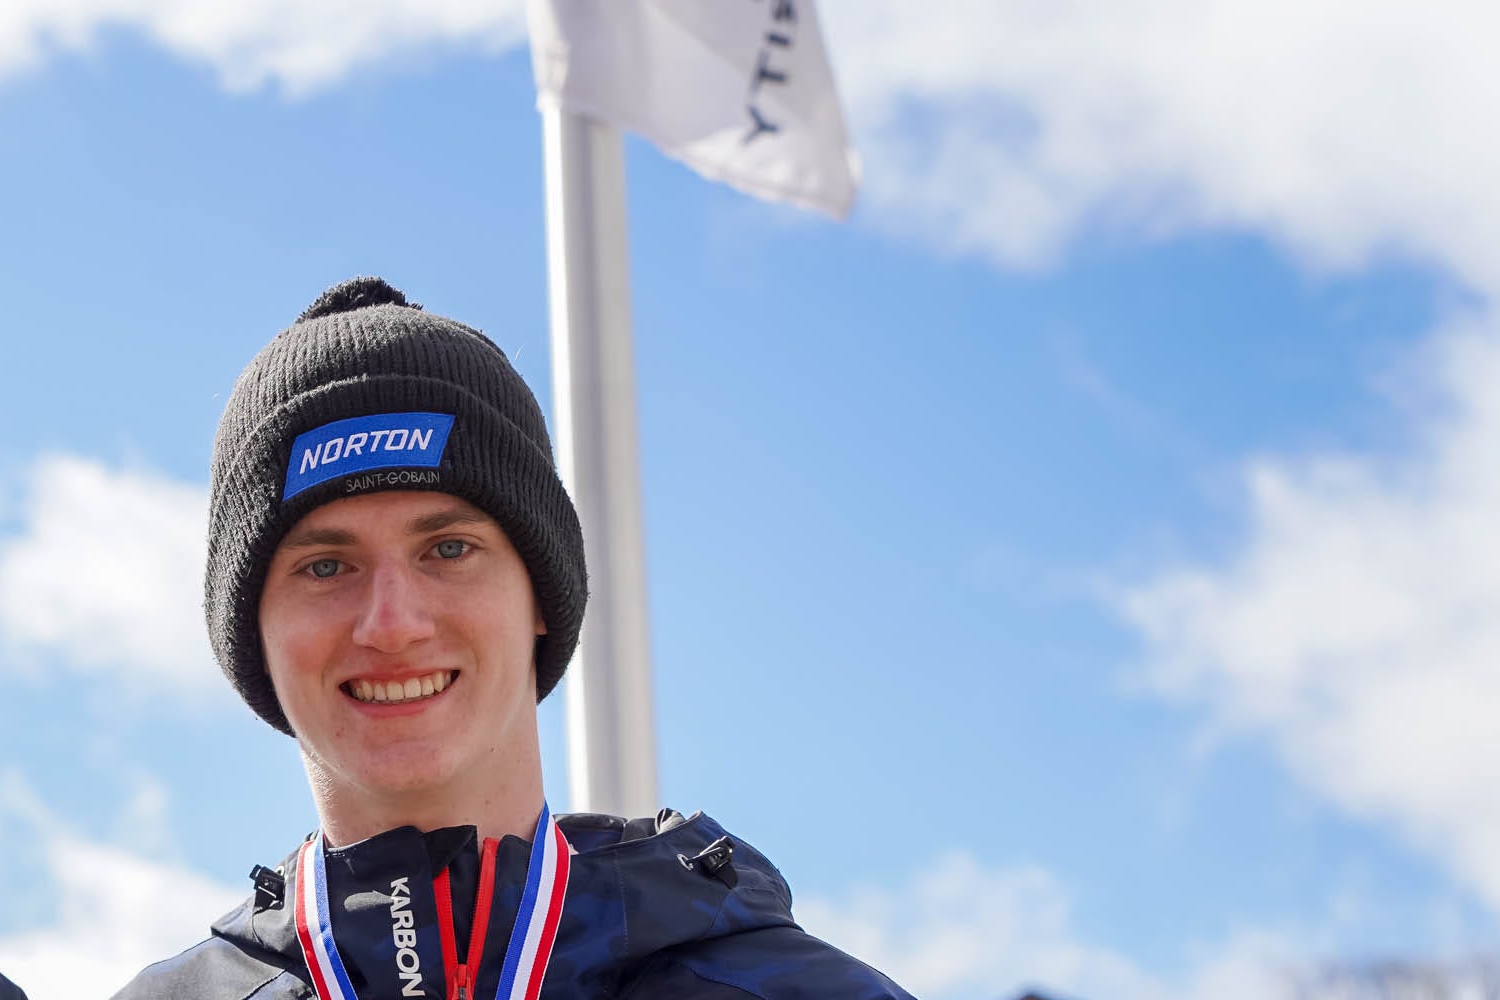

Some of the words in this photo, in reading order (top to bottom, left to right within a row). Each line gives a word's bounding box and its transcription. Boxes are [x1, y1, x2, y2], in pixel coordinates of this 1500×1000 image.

[299, 428, 434, 475] NORTON
[346, 470, 441, 493] SAINT-GOBAIN
[389, 876, 426, 997] KARBON
